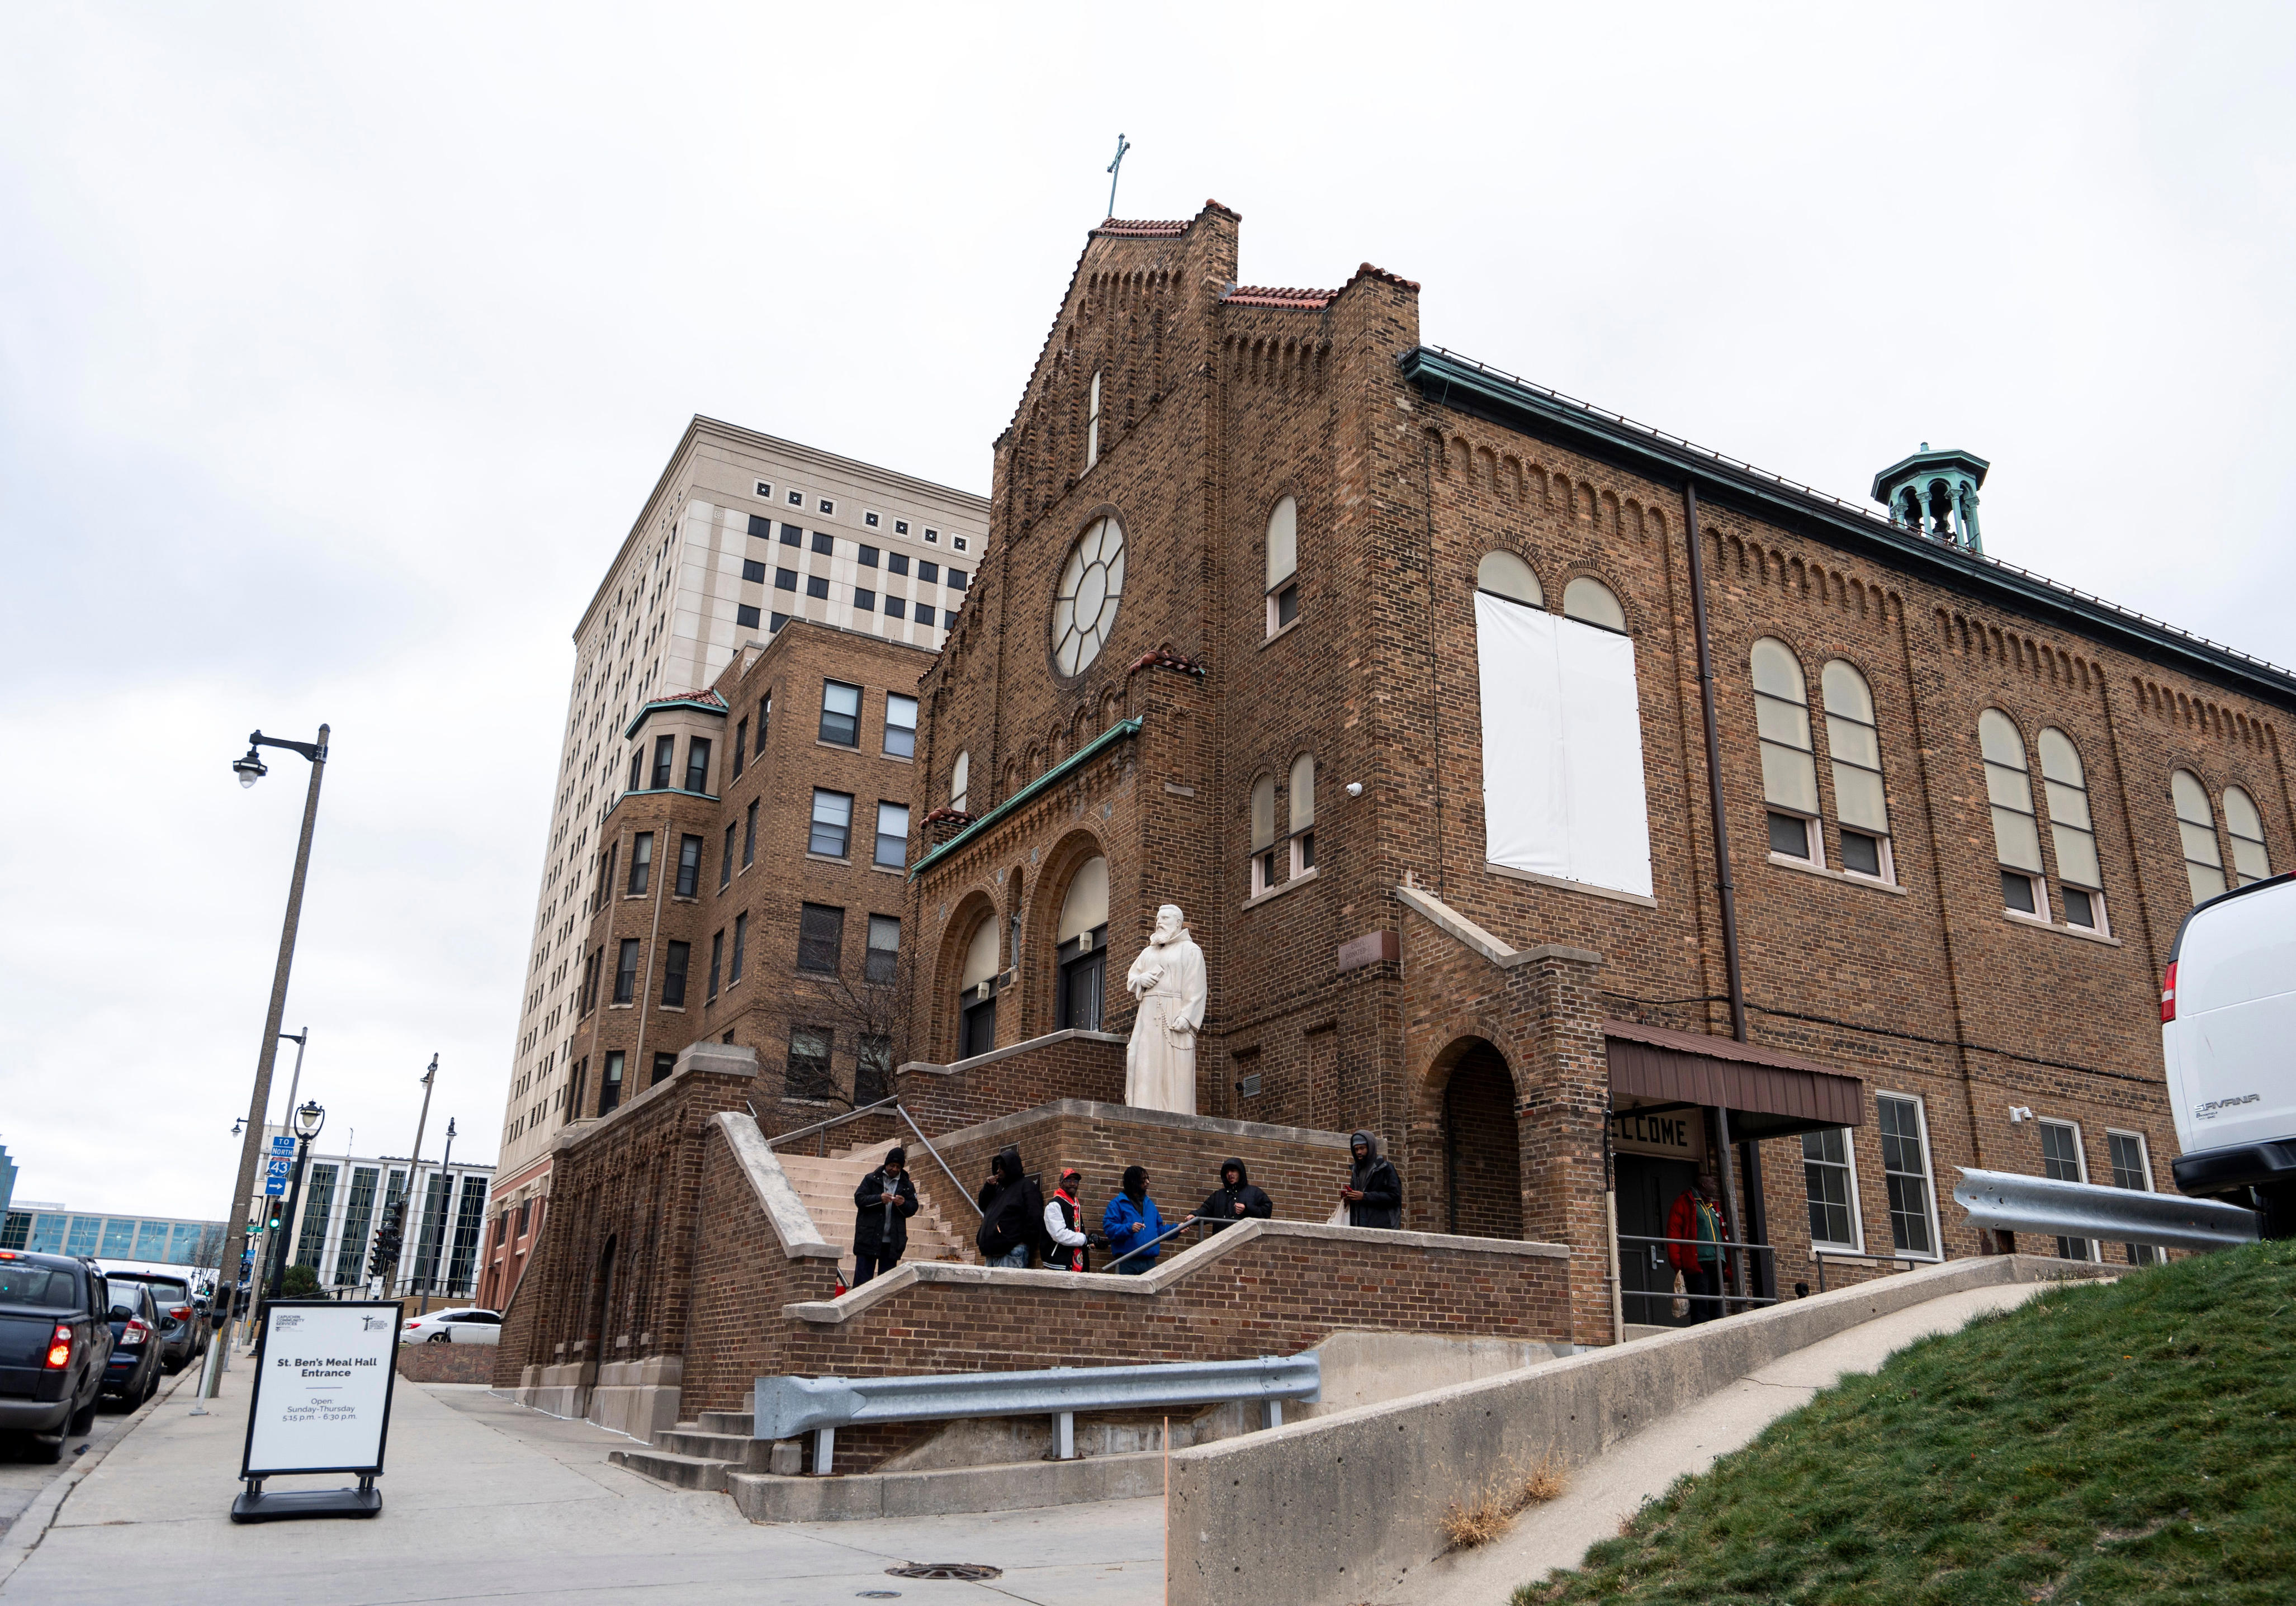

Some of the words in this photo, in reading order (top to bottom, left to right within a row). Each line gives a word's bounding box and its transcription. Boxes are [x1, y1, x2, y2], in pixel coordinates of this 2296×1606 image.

[2194, 1093, 2260, 1112] SAVANA
[271, 1162, 287, 1173] 43
[277, 1358, 291, 1367] St.
[295, 1358, 323, 1367] Ben's
[326, 1358, 352, 1366] Meal
[354, 1358, 377, 1366] Hall
[301, 1369, 351, 1377] Entrance
[287, 1405, 355, 1414] Sunday-Thursday
